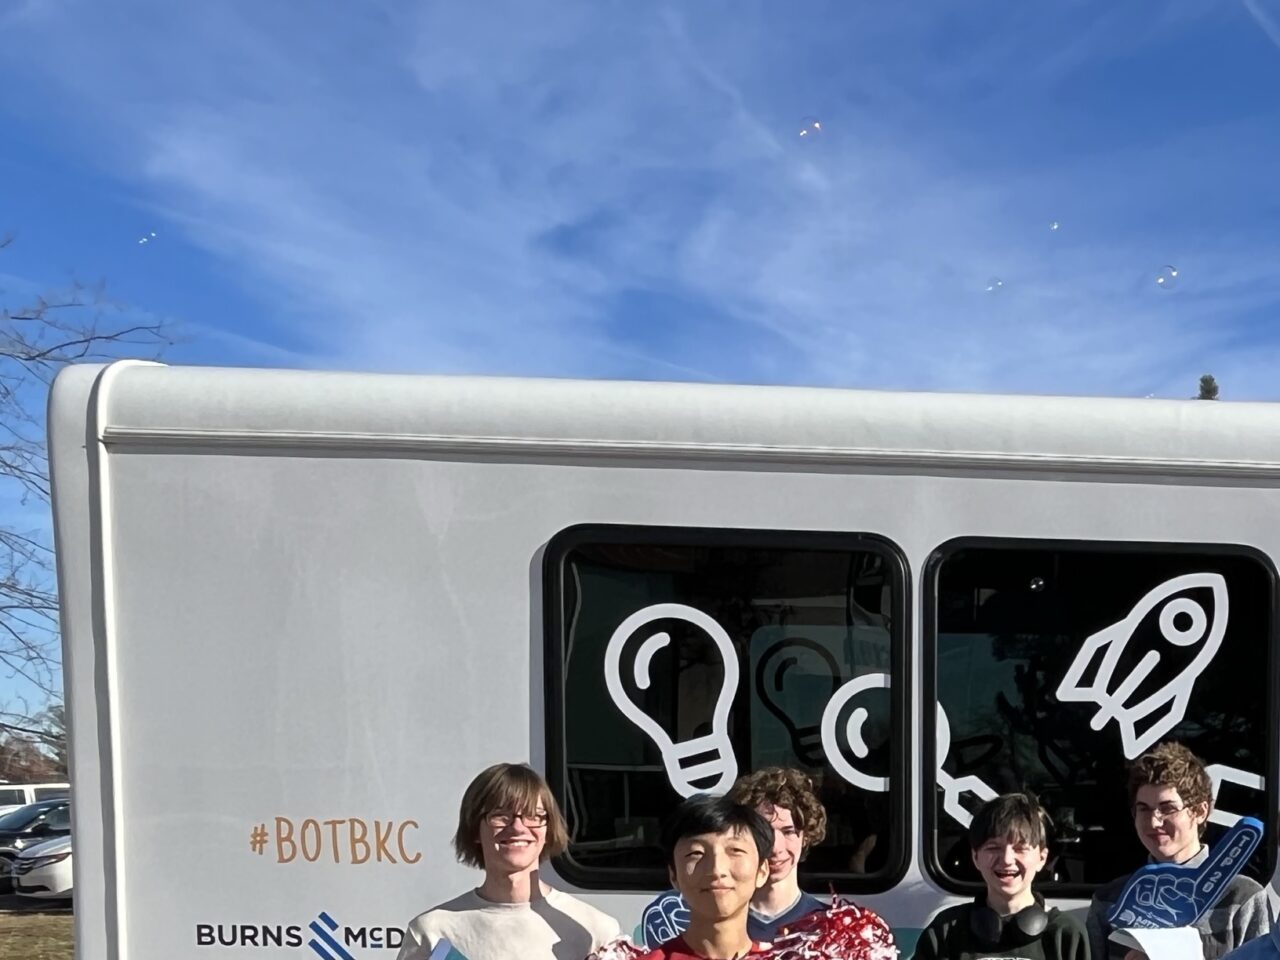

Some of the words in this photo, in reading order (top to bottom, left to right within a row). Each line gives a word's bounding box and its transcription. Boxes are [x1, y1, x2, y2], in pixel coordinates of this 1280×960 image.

[250, 817, 422, 864] #BOTBKC
[1220, 835, 1250, 868] TOP
[1202, 871, 1222, 893] 20
[197, 924, 302, 948] BURNS
